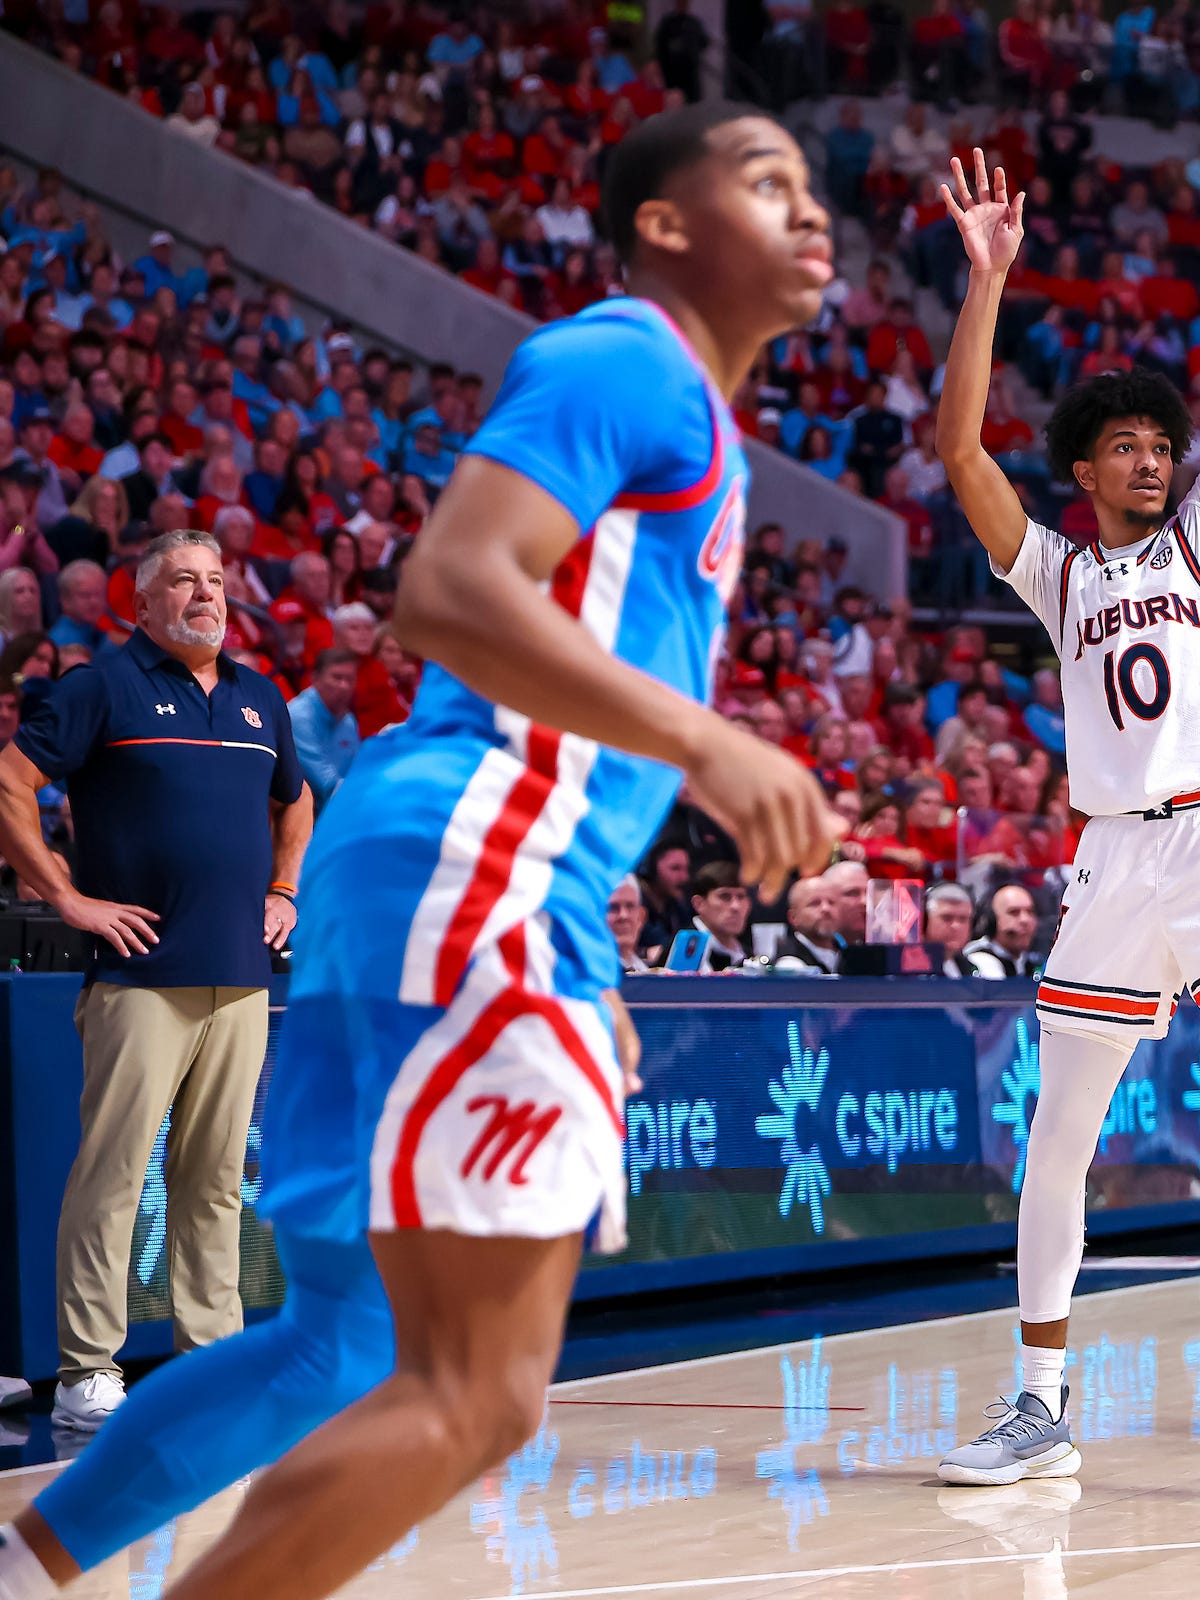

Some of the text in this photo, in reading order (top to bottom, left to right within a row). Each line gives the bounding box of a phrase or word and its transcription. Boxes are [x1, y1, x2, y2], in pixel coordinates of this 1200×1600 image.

[1151, 547, 1172, 569] SEC
[1103, 642, 1171, 732] 10
[620, 1097, 718, 1196] pire
